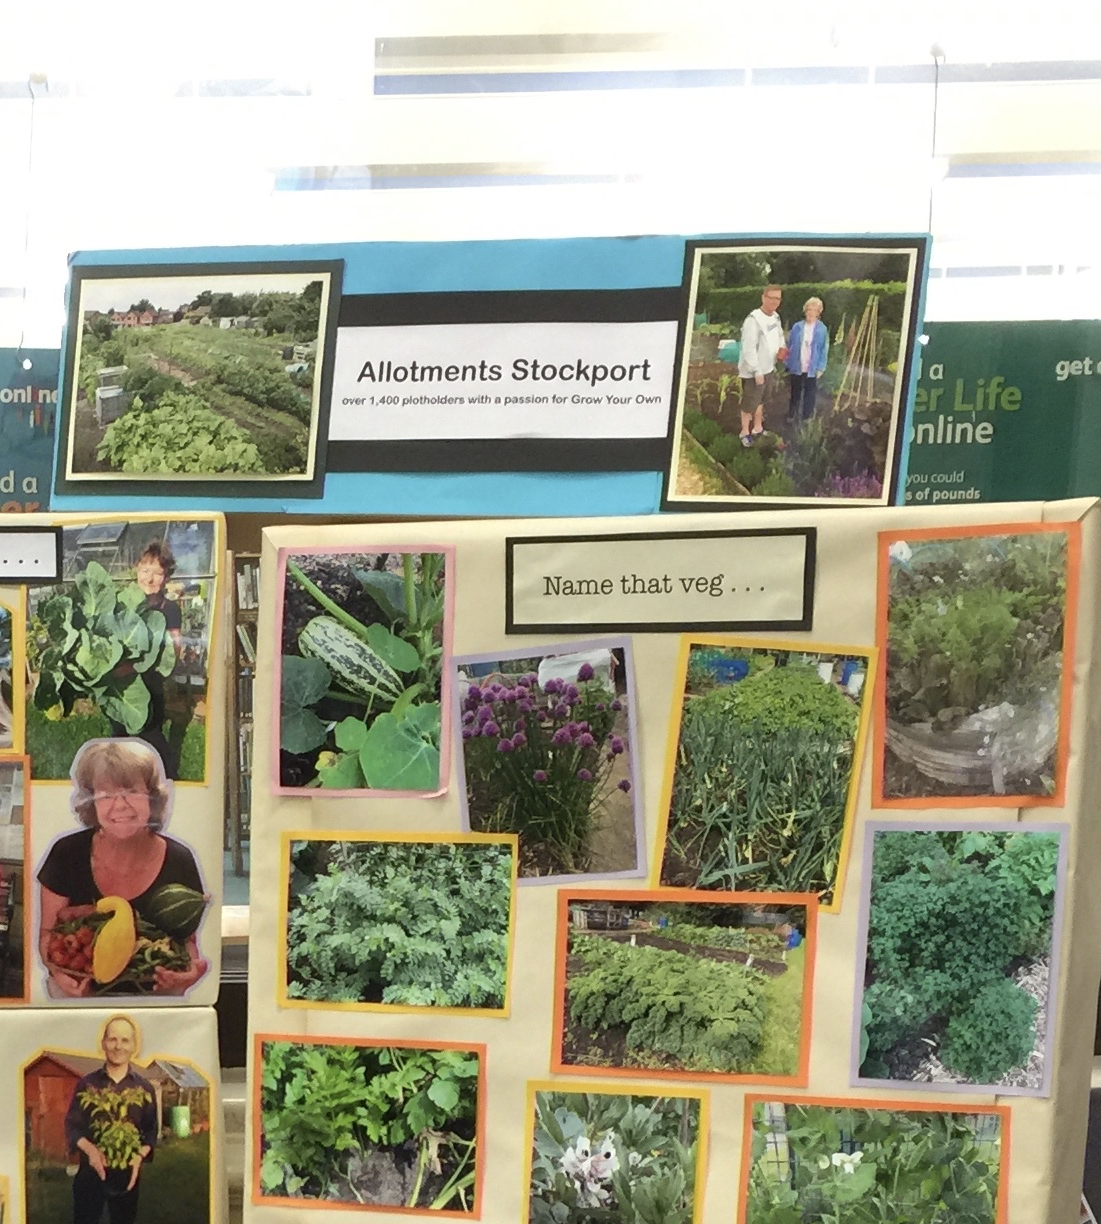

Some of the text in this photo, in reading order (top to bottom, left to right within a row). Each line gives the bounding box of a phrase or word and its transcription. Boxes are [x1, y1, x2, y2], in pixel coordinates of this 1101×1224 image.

[357, 358, 651, 387] Allotments Stockport
[1056, 356, 1092, 381] get
[342, 394, 661, 407] over 1,400 plotholders with a passion for Grow Your Own
[954, 376, 1022, 411] Life
[909, 415, 993, 444] nline
[23, 477, 37, 493] a
[931, 471, 964, 483] could
[916, 488, 930, 500] of
[933, 487, 980, 502] pounds
[543, 574, 724, 596] Name that veg
